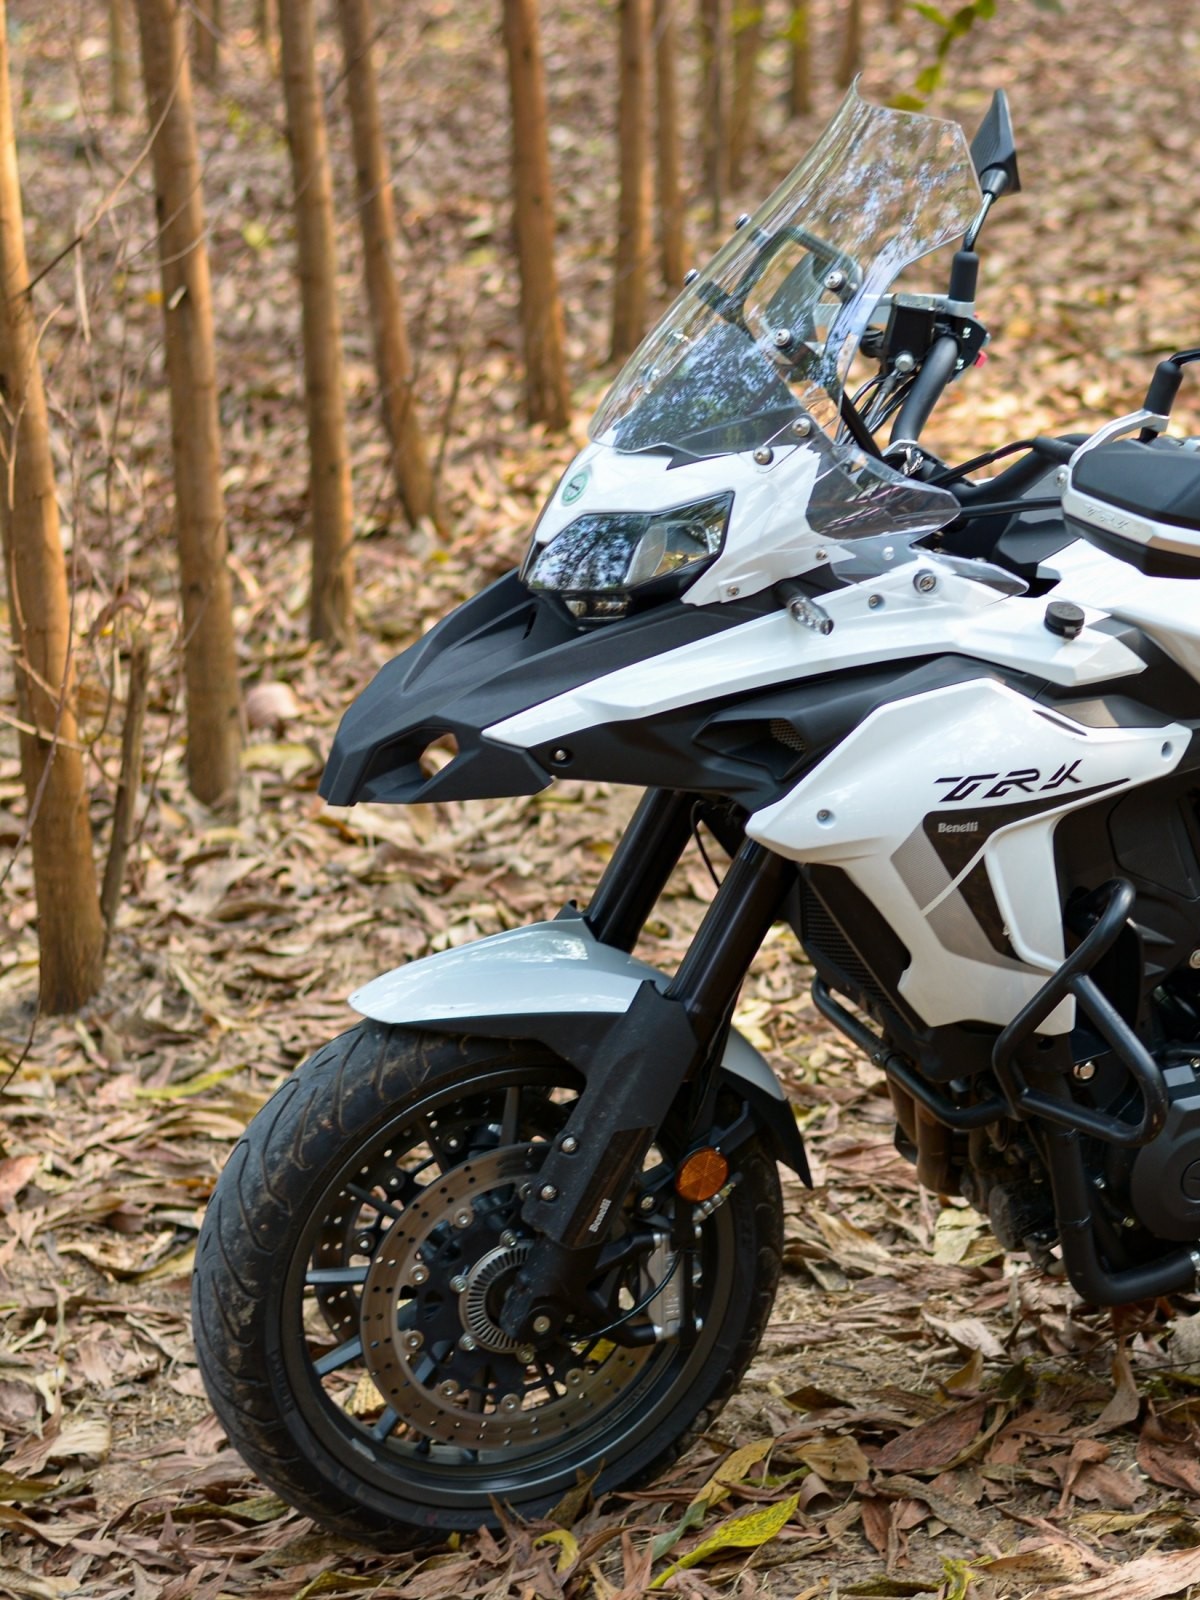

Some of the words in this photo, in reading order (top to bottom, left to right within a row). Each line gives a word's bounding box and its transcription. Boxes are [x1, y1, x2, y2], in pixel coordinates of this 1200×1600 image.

[934, 759, 1082, 802] TRK
[938, 821, 978, 833] Benelli
[588, 1198, 611, 1232] Benelli
